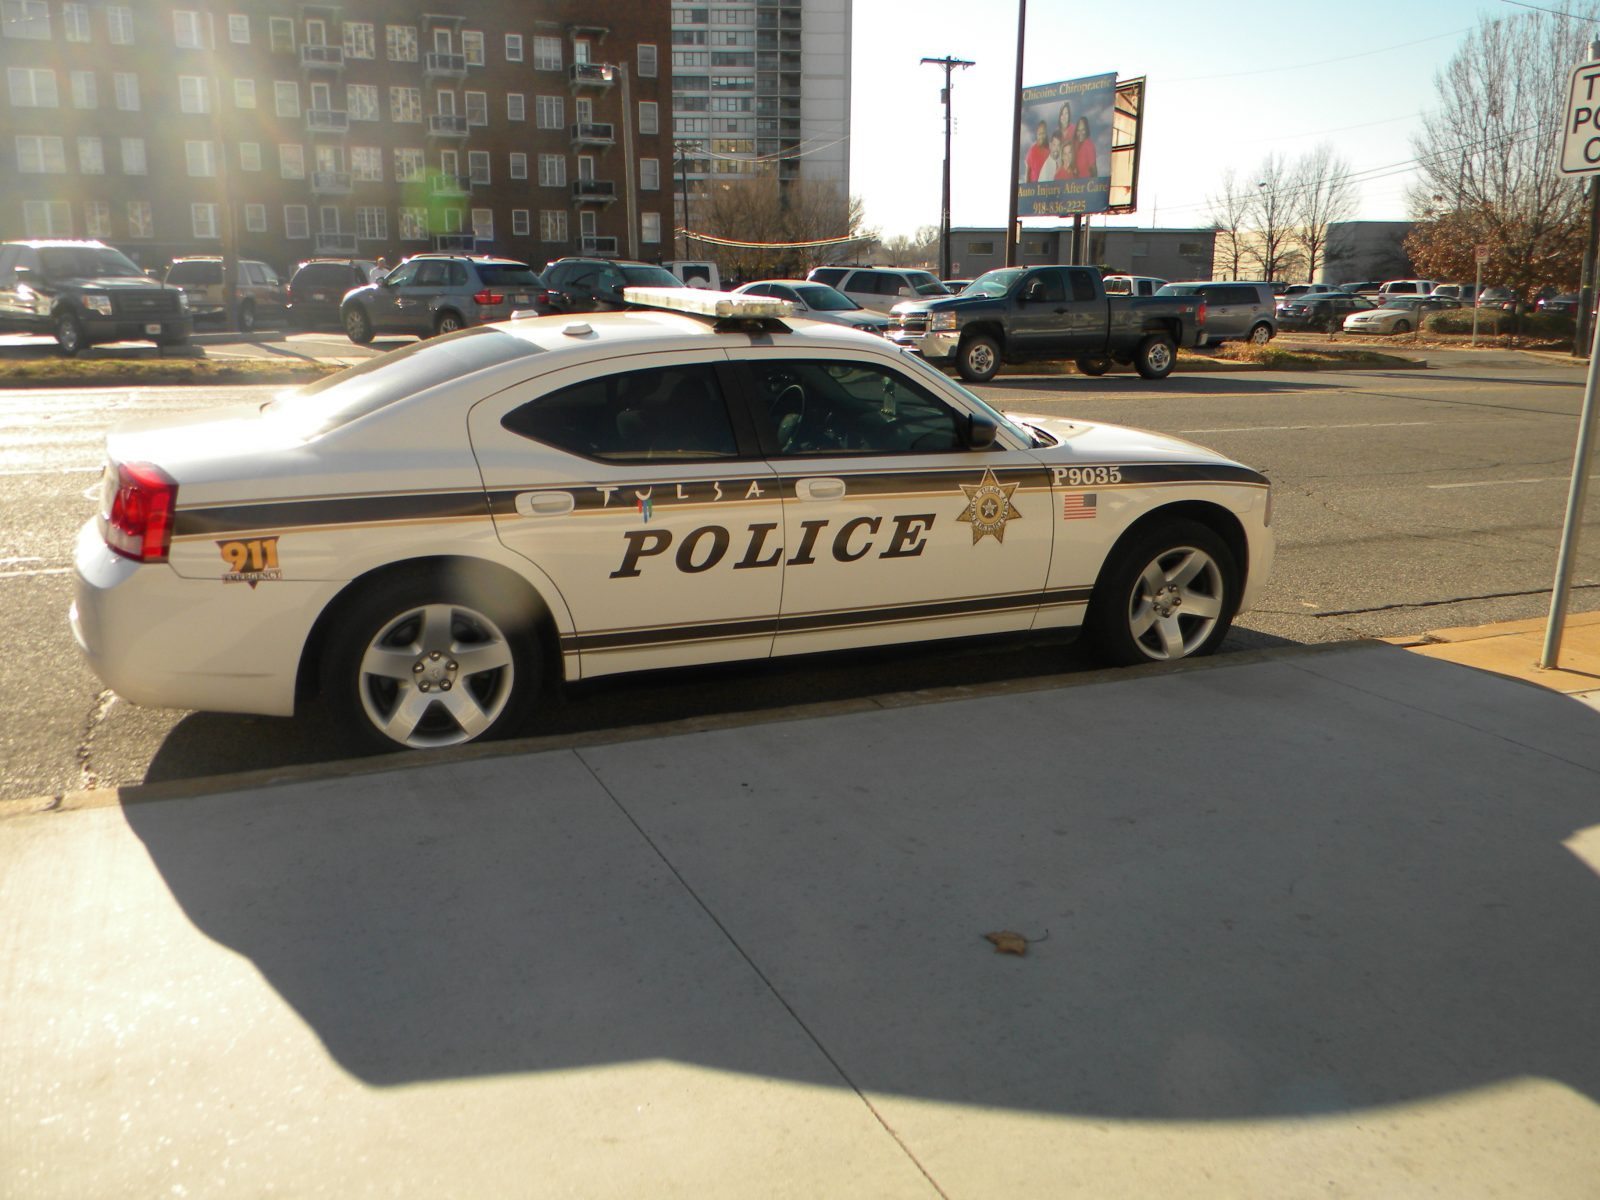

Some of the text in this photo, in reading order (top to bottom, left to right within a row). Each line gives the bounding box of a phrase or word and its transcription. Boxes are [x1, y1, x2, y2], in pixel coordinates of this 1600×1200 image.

[1060, 78, 1112, 96] Chiropractic
[1018, 180, 1107, 198] Auto Injury After Care
[1052, 466, 1122, 486] P9035
[596, 480, 765, 508] TULSA
[980, 486, 1001, 496] TULSA
[221, 540, 279, 571] 911
[609, 513, 937, 579] POLICE
